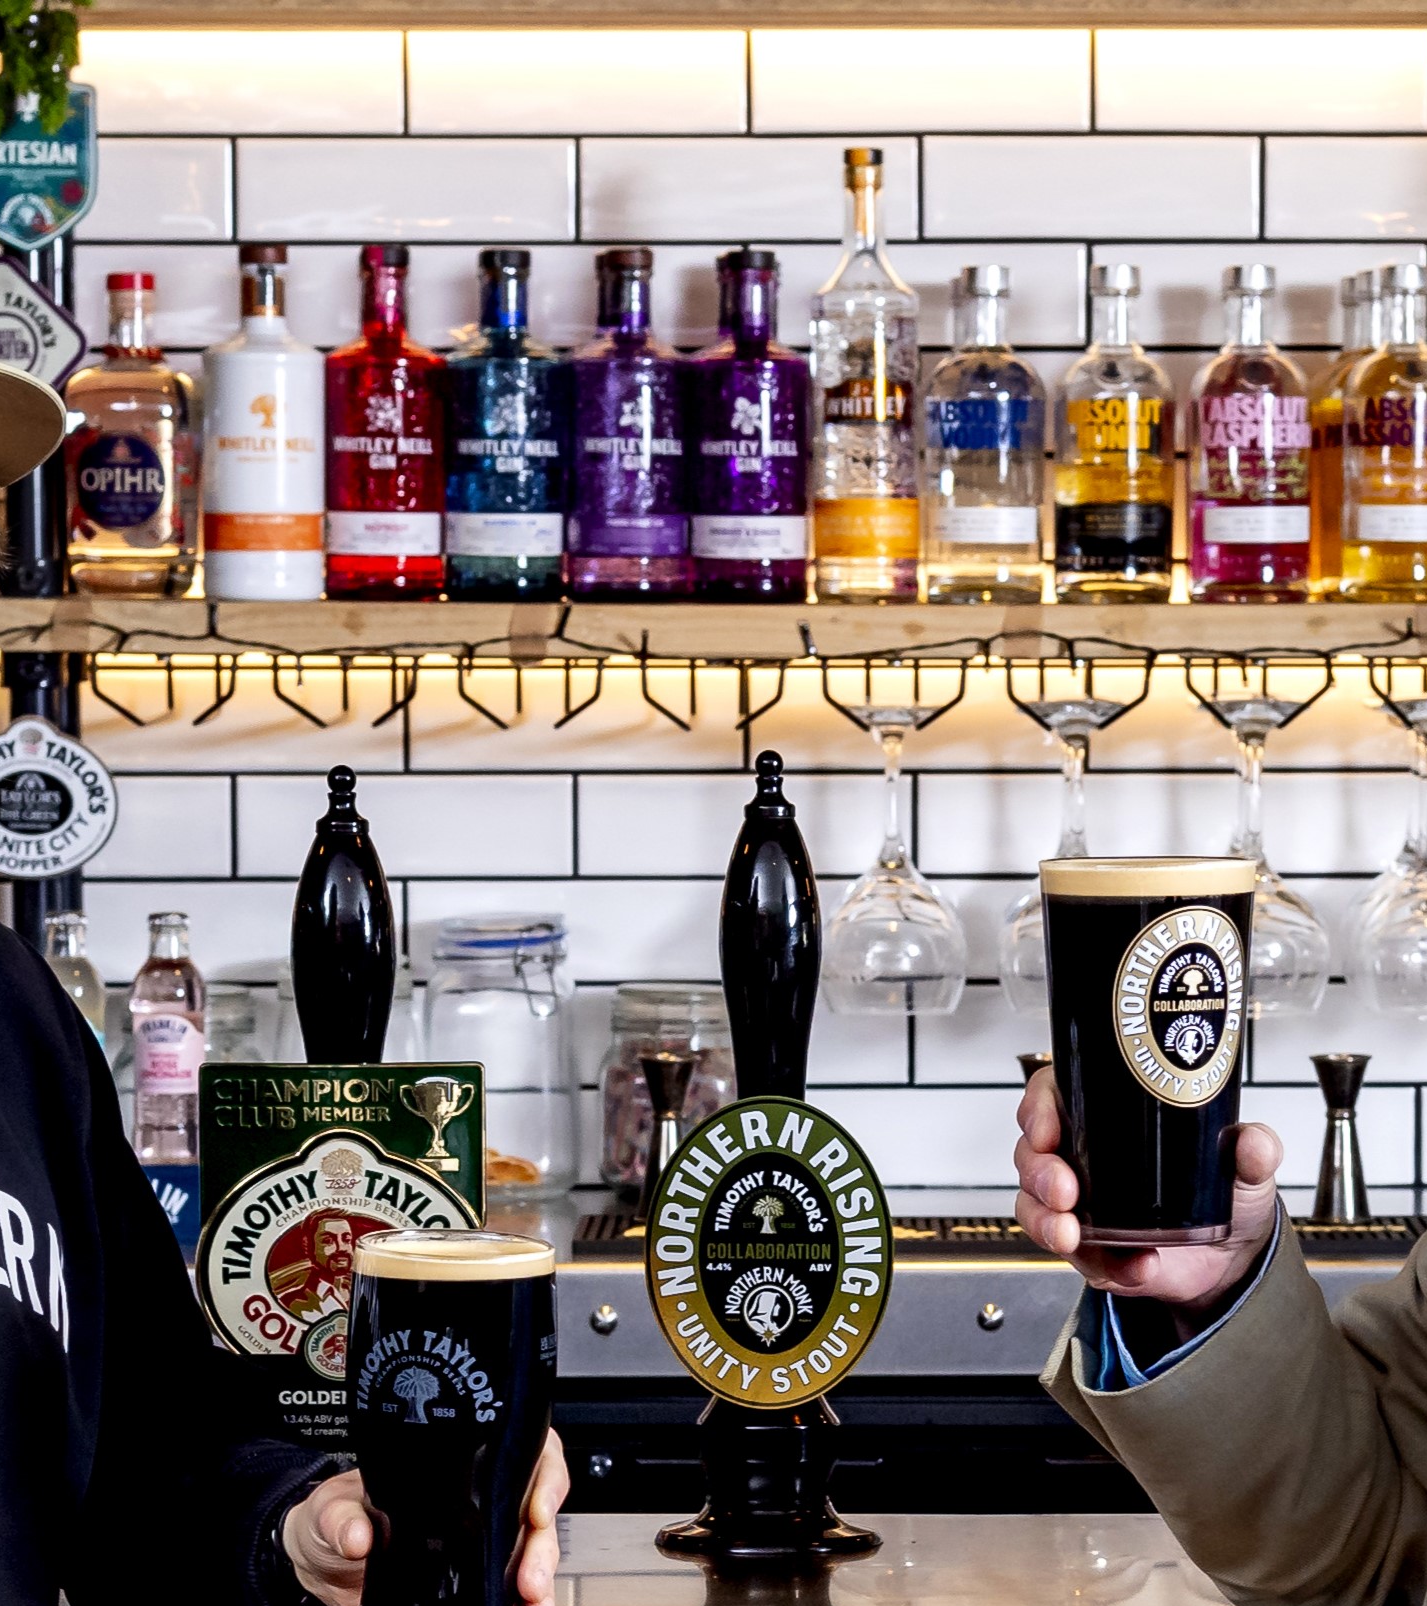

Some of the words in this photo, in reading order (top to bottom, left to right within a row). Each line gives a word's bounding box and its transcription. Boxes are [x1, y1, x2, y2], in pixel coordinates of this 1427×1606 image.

[827, 396, 906, 416] WHITEY
[81, 467, 165, 493] OPIHR
[46, 741, 110, 815] TAYLOR'S
[49, 812, 91, 852] CITY
[1121, 915, 1221, 1036] NORTHERN
[1217, 931, 1243, 1031] RISING
[1159, 953, 1192, 994] TIMOTHY
[1196, 953, 1225, 992] TAYLOR'S
[1154, 998, 1225, 1012] COLLABORATION
[1165, 1014, 1202, 1047] NORTHERN
[1133, 1046, 1185, 1095] UNITY
[1191, 1046, 1233, 1096] STOUT
[213, 1078, 395, 1103] CHAMPION
[214, 1105, 297, 1129] CLUB
[303, 1106, 391, 1122] MEMBER
[324, 1179, 362, 1190] 1858
[275, 1197, 371, 1228] CHAMPIONSHIP
[374, 1202, 410, 1226] BEERS
[656, 1110, 814, 1298] NORTHERN
[808, 1137, 882, 1297] RISING
[714, 1171, 765, 1231] TIMOTHY
[772, 1171, 829, 1232] TAYLOR'S
[222, 1170, 318, 1285] TIMOTHY
[364, 1171, 451, 1228] TAYLO
[706, 1263, 732, 1271] 4.4%
[809, 1263, 832, 1272] ABV
[707, 1243, 831, 1260] COLLABORATION
[725, 1266, 785, 1315] NORTHERN
[783, 1273, 813, 1315] MONK
[311, 1323, 336, 1352] TIMOTHY
[677, 1314, 760, 1391] UNITY
[771, 1315, 860, 1393] STOUT
[357, 1330, 411, 1410] TIMOTHY
[424, 1330, 503, 1423] TAYLOR'S
[375, 1355, 441, 1388] CHAMPIONSHIP
[442, 1367, 466, 1396] BEERS
[290, 1415, 312, 1424] 3.4%
[314, 1415, 332, 1424] ABV
[383, 1403, 399, 1413] EST
[432, 1407, 456, 1418] 1858
